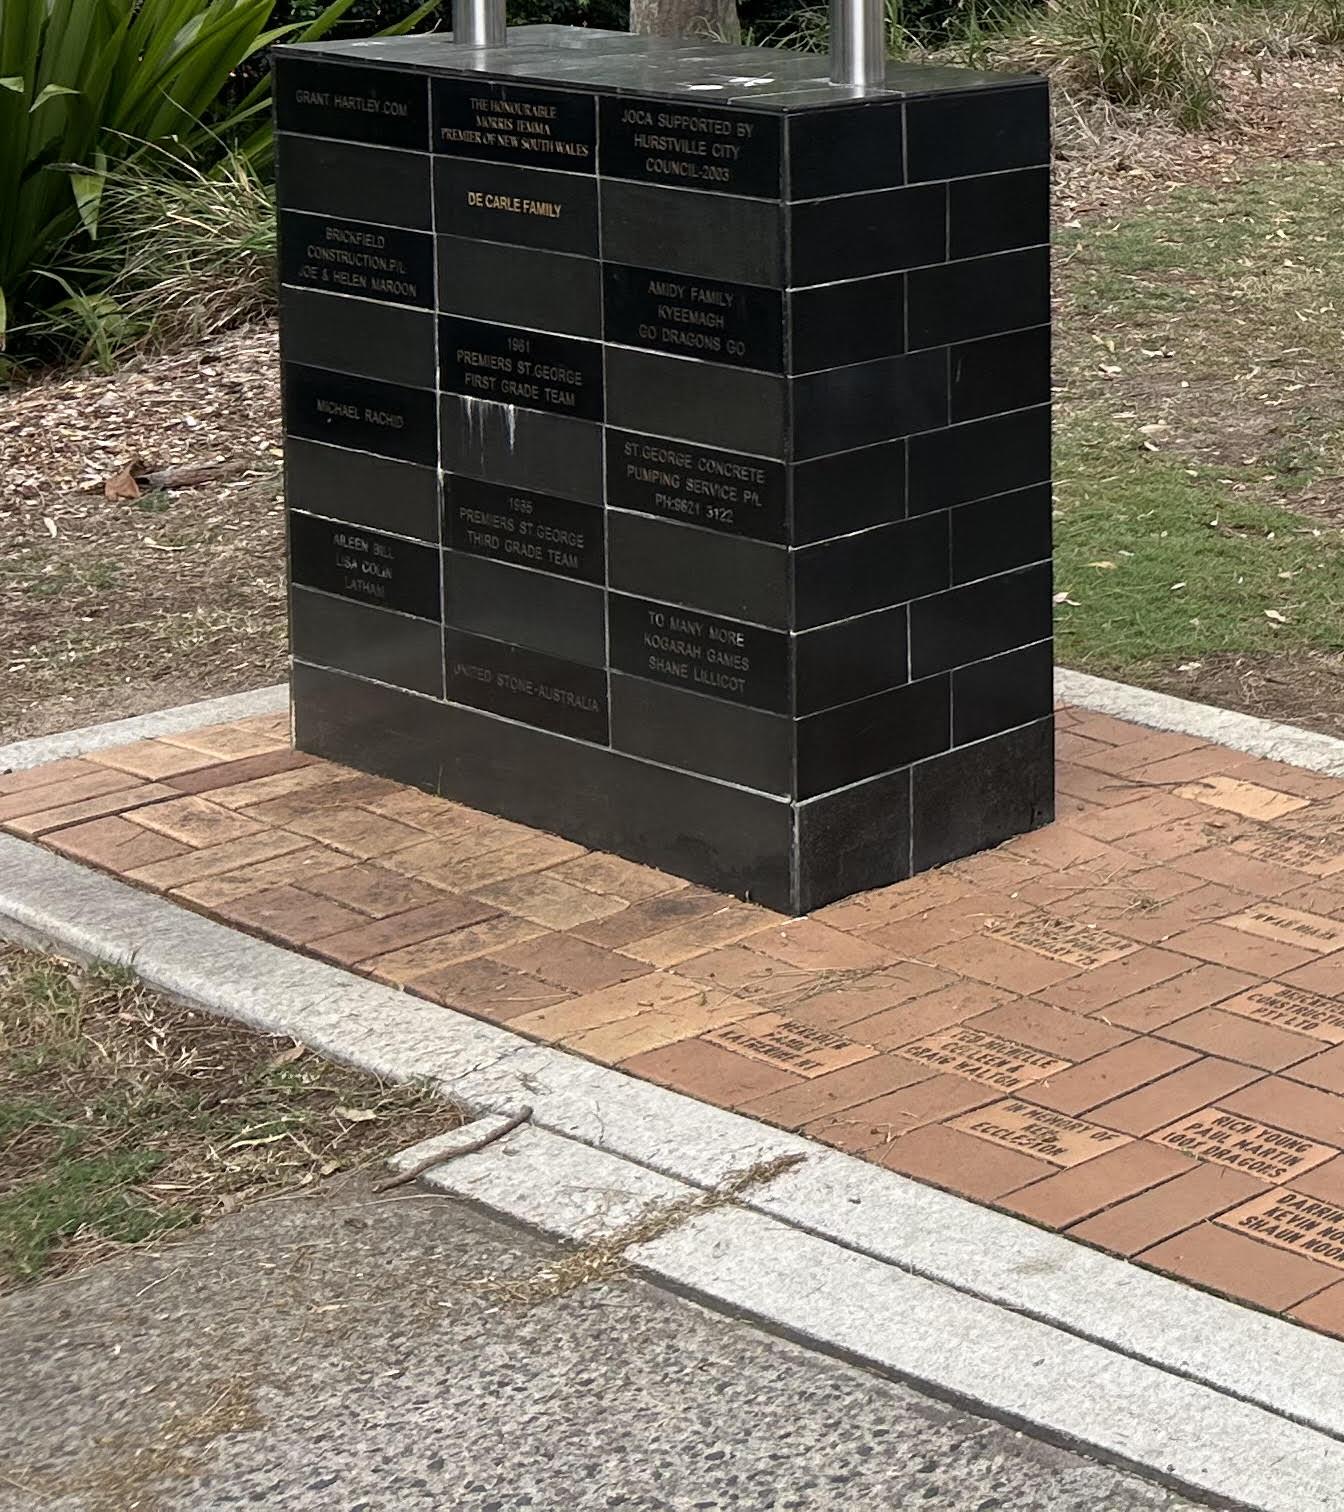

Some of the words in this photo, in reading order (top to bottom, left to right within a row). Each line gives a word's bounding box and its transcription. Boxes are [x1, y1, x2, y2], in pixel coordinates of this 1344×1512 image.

[296, 90, 329, 106] GRANT
[470, 98, 488, 112] THE
[490, 101, 558, 119] HONOURABLE
[622, 109, 653, 125] JOCA
[658, 113, 732, 135] SUPPORTED
[736, 122, 754, 138] BY
[483, 132, 496, 145] OF
[496, 134, 519, 148] NEW
[521, 137, 553, 152] SOUTH
[555, 141, 589, 157] WALES
[634, 134, 707, 155] HURSTVILLE
[712, 143, 740, 160] CITY
[468, 192, 484, 208] DE
[485, 194, 520, 213] CARLE
[523, 199, 562, 218] FAMILY
[691, 288, 735, 307] FAMILY
[639, 323, 656, 339] GO
[662, 328, 720, 351] DRAGONS
[726, 339, 746, 356] GO
[456, 349, 512, 372] PREMIERS
[464, 372, 496, 389] FIRST
[501, 379, 539, 400] GRADE
[544, 388, 575, 406] TEAM
[626, 464, 680, 488] PUMPING
[685, 478, 738, 502] SERVICE
[697, 457, 767, 484] CONCRETE
[648, 611, 664, 627] TO
[670, 616, 702, 636] MANY
[709, 626, 744, 648] MORE
[643, 632, 701, 658] KOGARAH
[707, 648, 750, 671] GAMES
[648, 656, 688, 678] SHANE
[694, 668, 745, 693] LILLICOT
[1183, 1122, 1232, 1144] PAUL
[1231, 1139, 1304, 1167] MARTIN
[1211, 1116, 1257, 1135] RICH
[1255, 1129, 1313, 1153] YOUNG
[1200, 1145, 1287, 1178] DRAGONS
[1238, 1215, 1305, 1244] SHAUN
[1262, 1206, 1321, 1231] KEVIN
